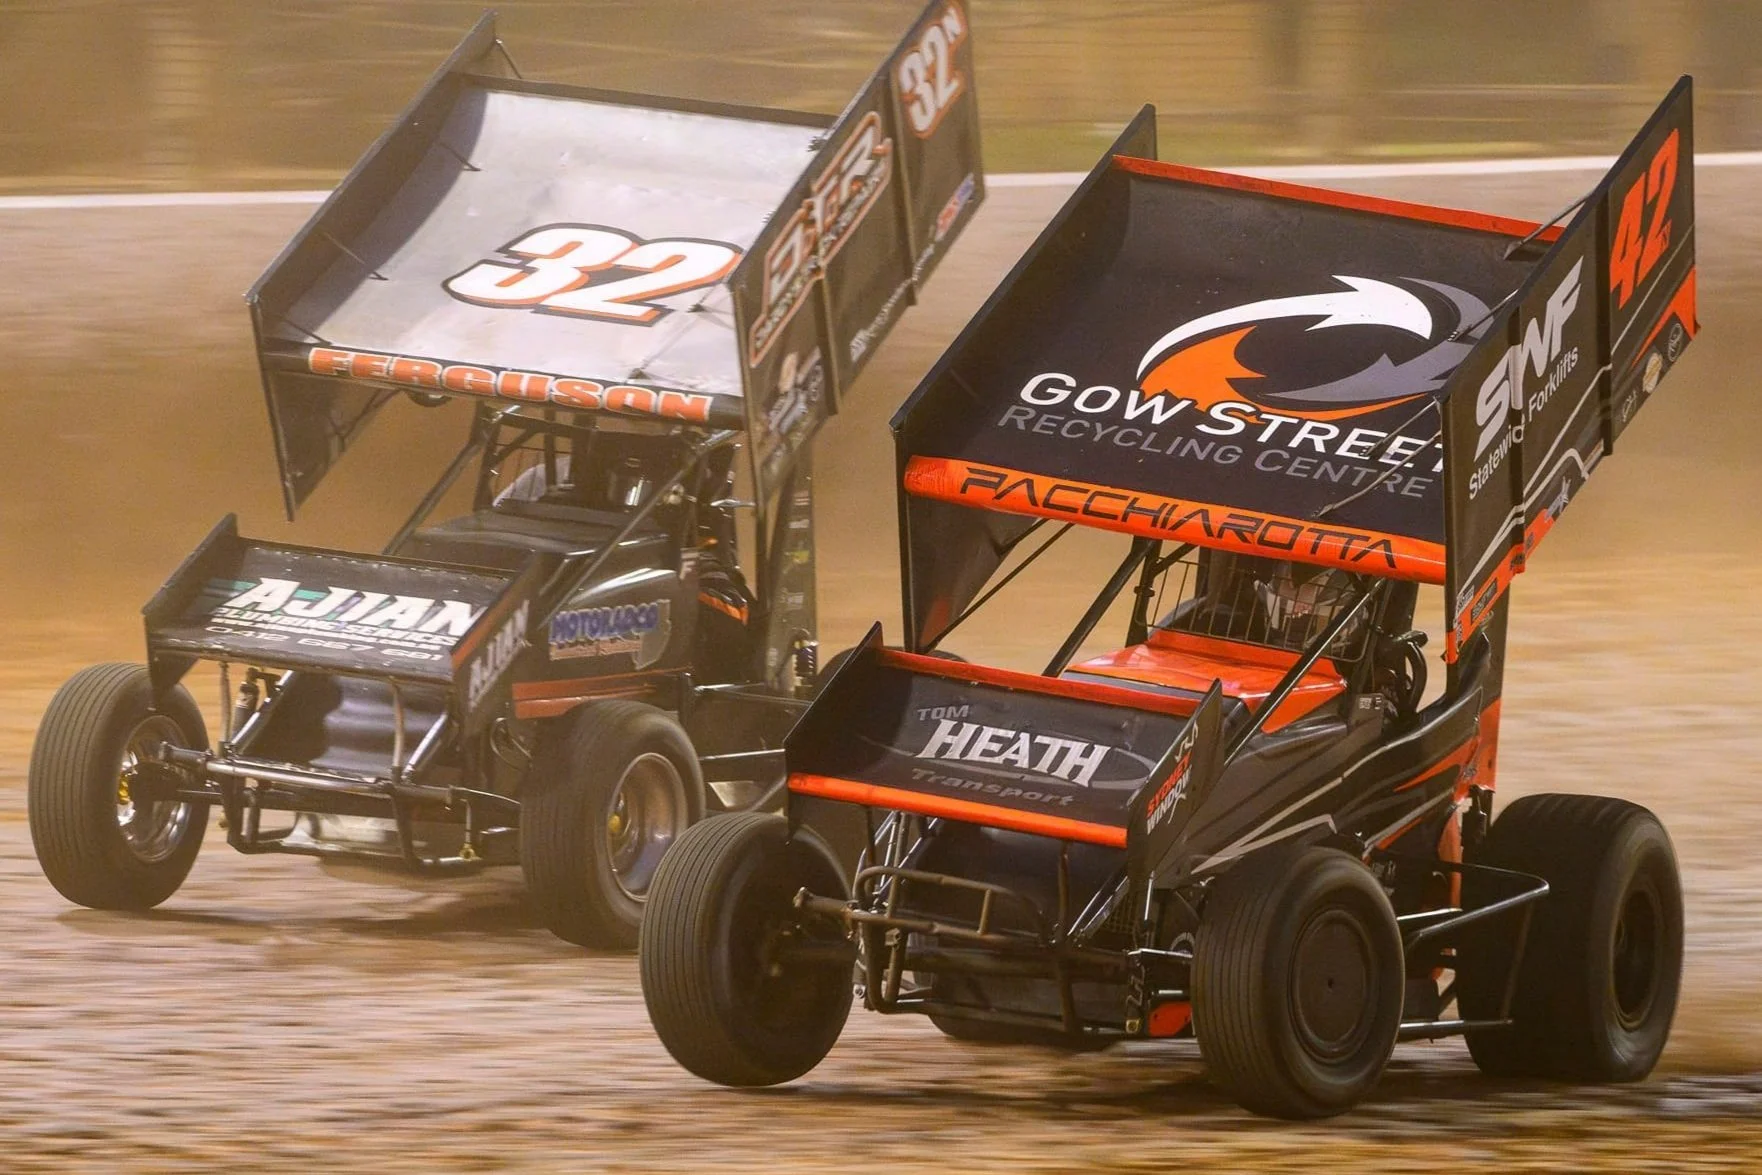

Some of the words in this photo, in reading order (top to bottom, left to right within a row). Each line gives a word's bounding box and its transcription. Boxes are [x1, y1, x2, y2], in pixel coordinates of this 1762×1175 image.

[441, 223, 744, 327] 32
[309, 347, 714, 422] FERGUSON
[1474, 256, 1583, 462] SWF
[1020, 372, 1192, 425] GOW
[1469, 412, 1525, 500] Statewid
[1528, 346, 1578, 423] Forklifts
[998, 405, 1243, 465] RECYCLING
[1254, 449, 1434, 498] CENTRE
[959, 467, 1398, 569] PACCHIAROTTA
[205, 626, 290, 641] 0412
[210, 608, 338, 630] PLUMBING
[343, 624, 460, 646] SERVICES
[917, 705, 970, 721] TOM
[911, 768, 1076, 806] Transport
[915, 718, 1111, 788] HEATH
[1147, 748, 1192, 818] SYDNEY
